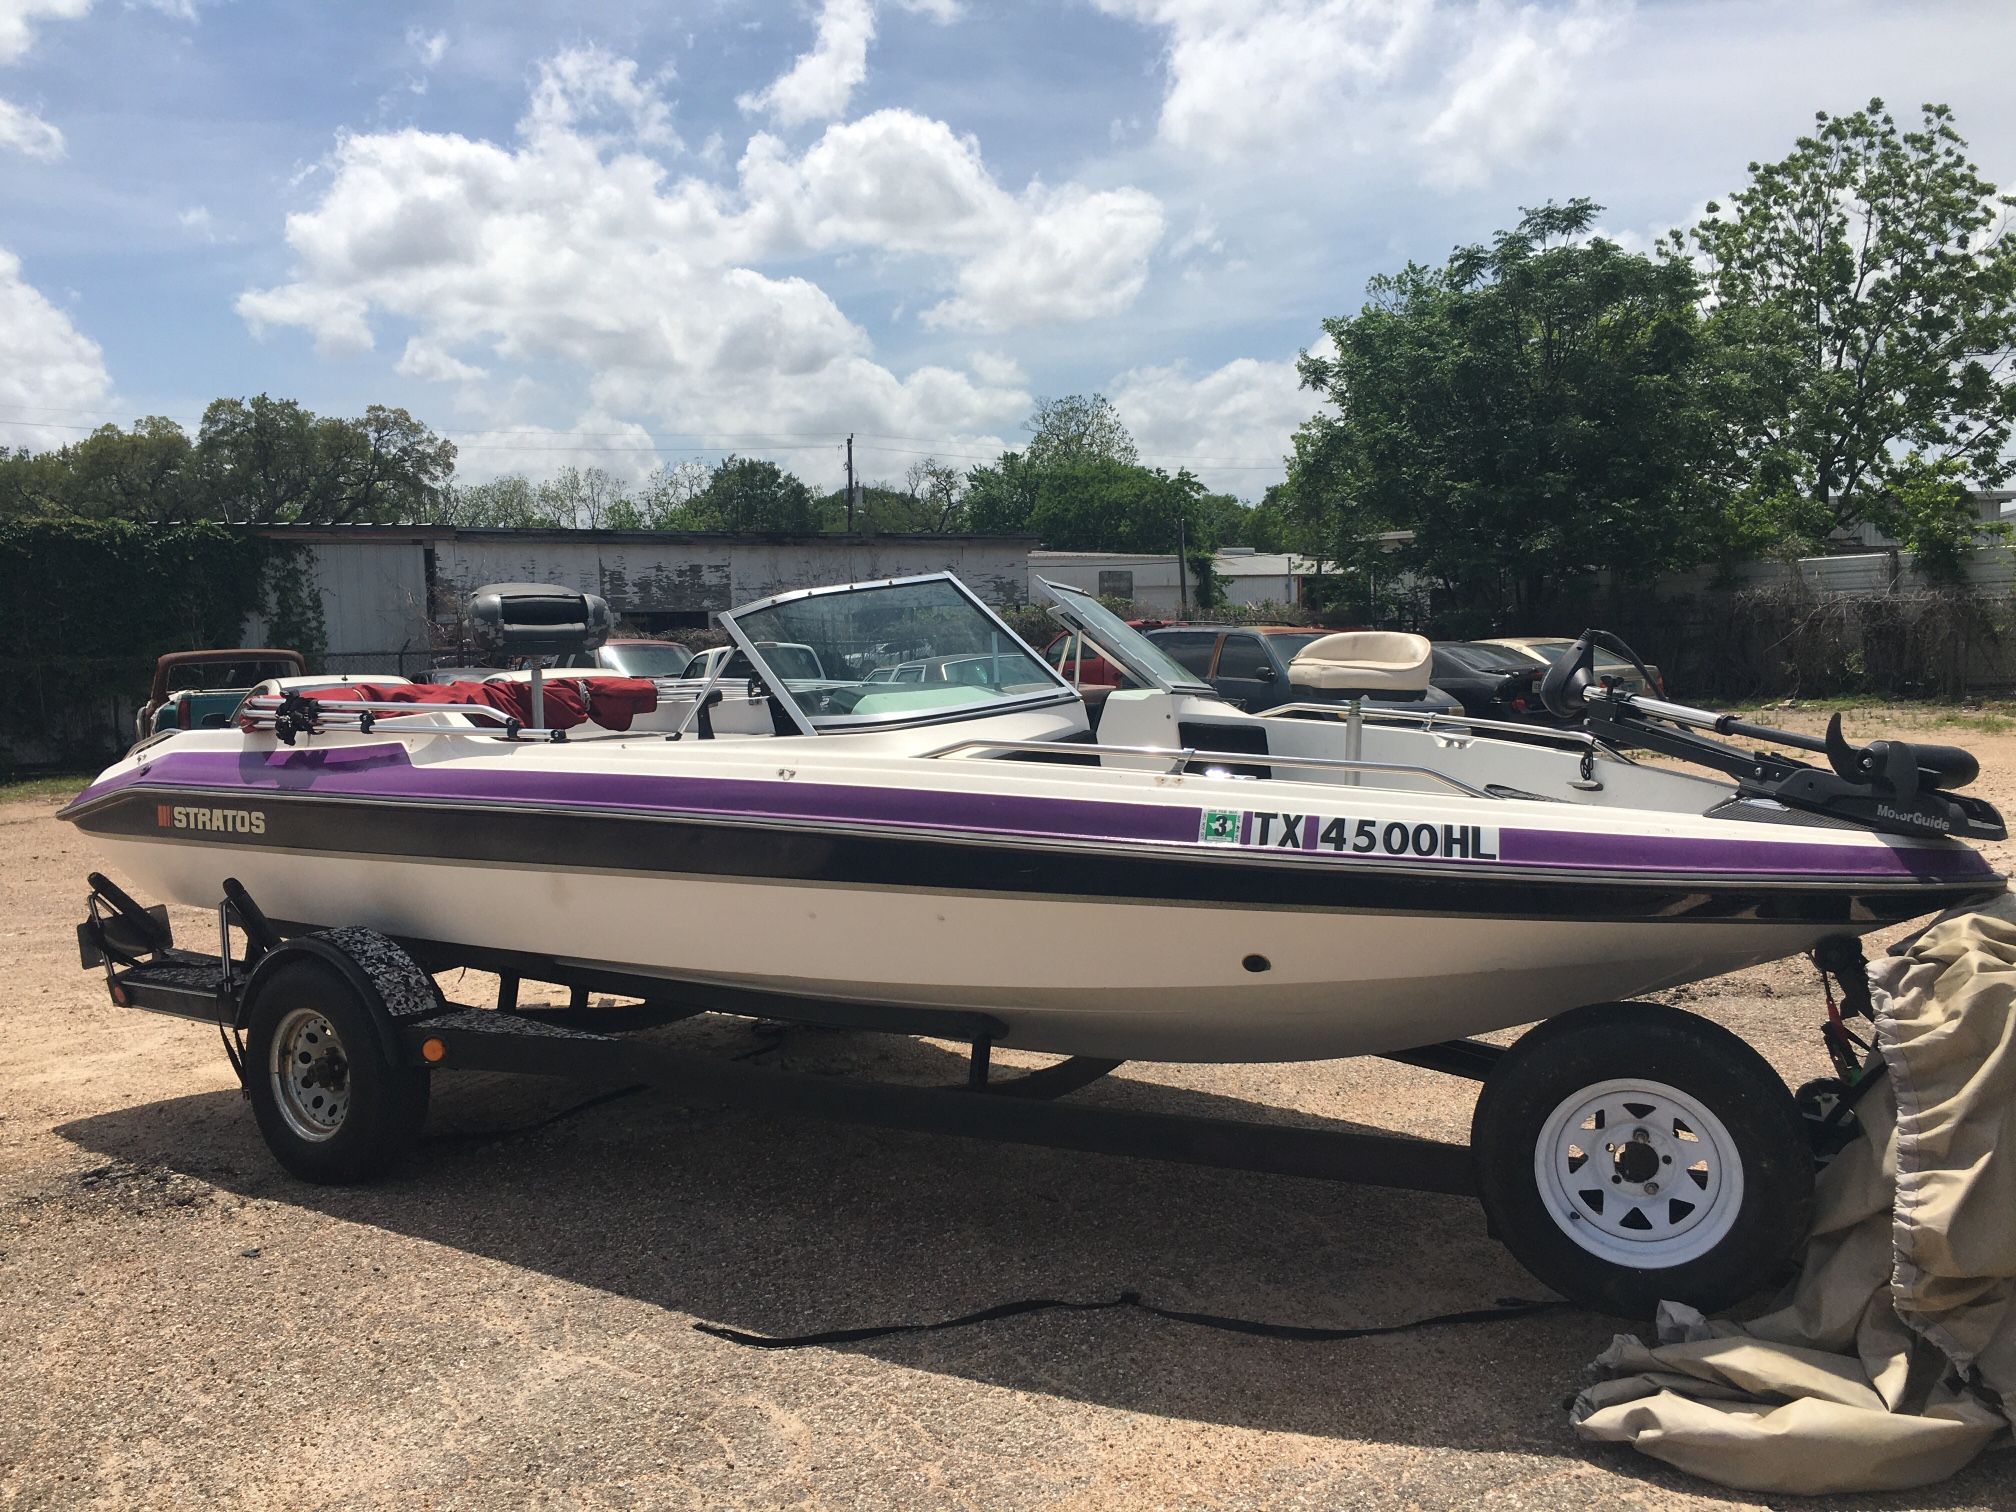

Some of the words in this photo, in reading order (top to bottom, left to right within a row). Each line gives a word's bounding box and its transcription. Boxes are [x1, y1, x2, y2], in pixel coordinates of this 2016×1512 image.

[173, 806, 266, 834] STRATOS
[1214, 815, 1228, 837] 3
[1254, 812, 1304, 849] TX
[1320, 818, 1496, 860] 4500HL
